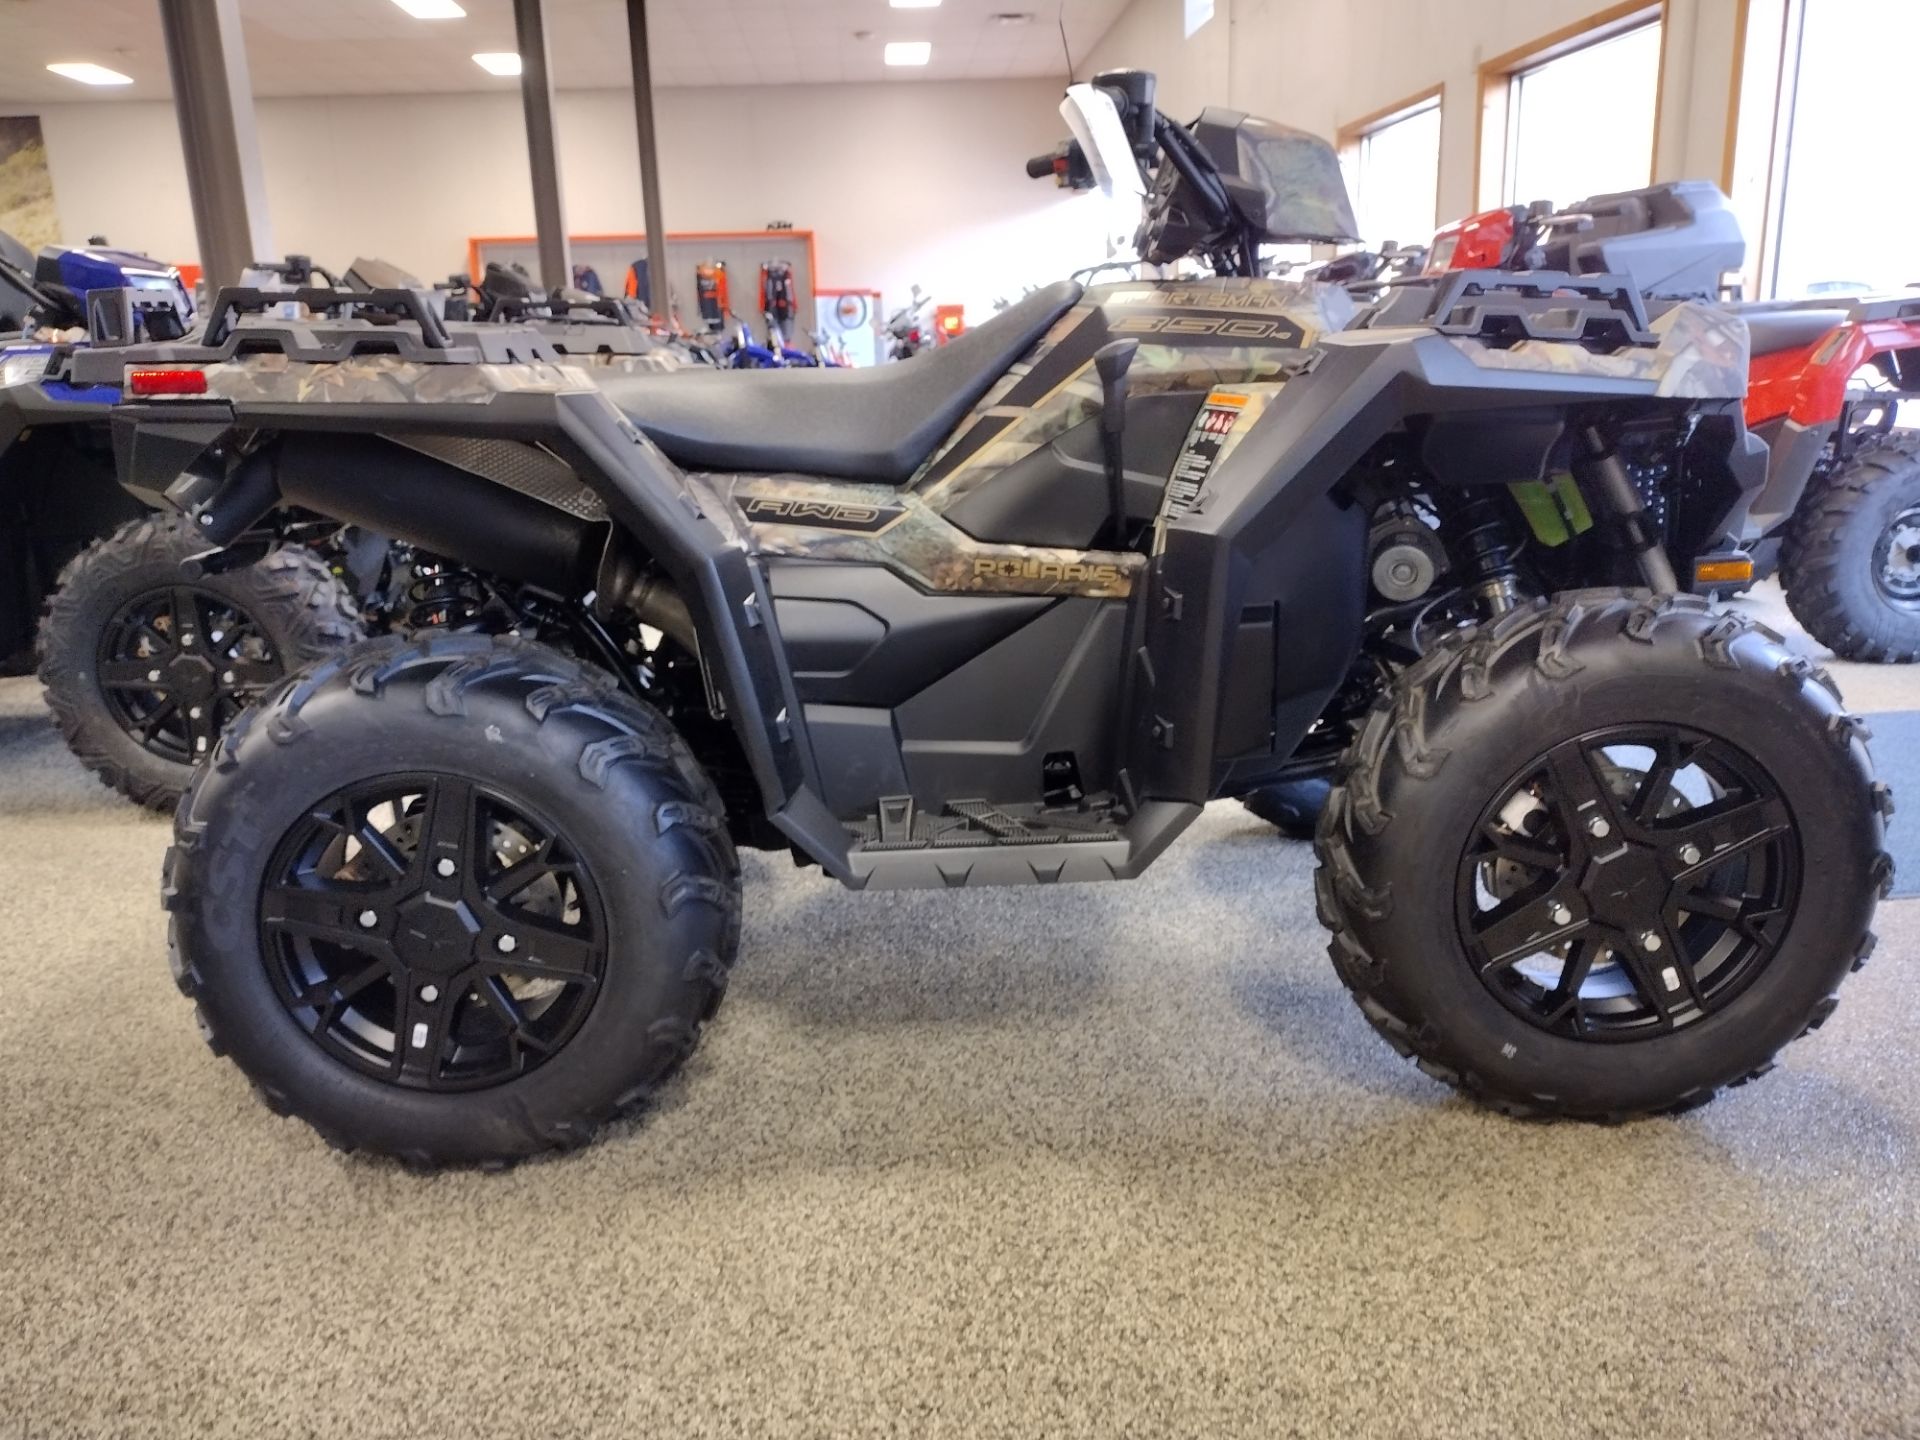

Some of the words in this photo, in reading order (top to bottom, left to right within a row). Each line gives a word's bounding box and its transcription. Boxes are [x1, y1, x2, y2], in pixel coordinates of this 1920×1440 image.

[1107, 315, 1279, 338] 850
[747, 498, 879, 523] AWD
[974, 558, 1118, 581] POLARIS
